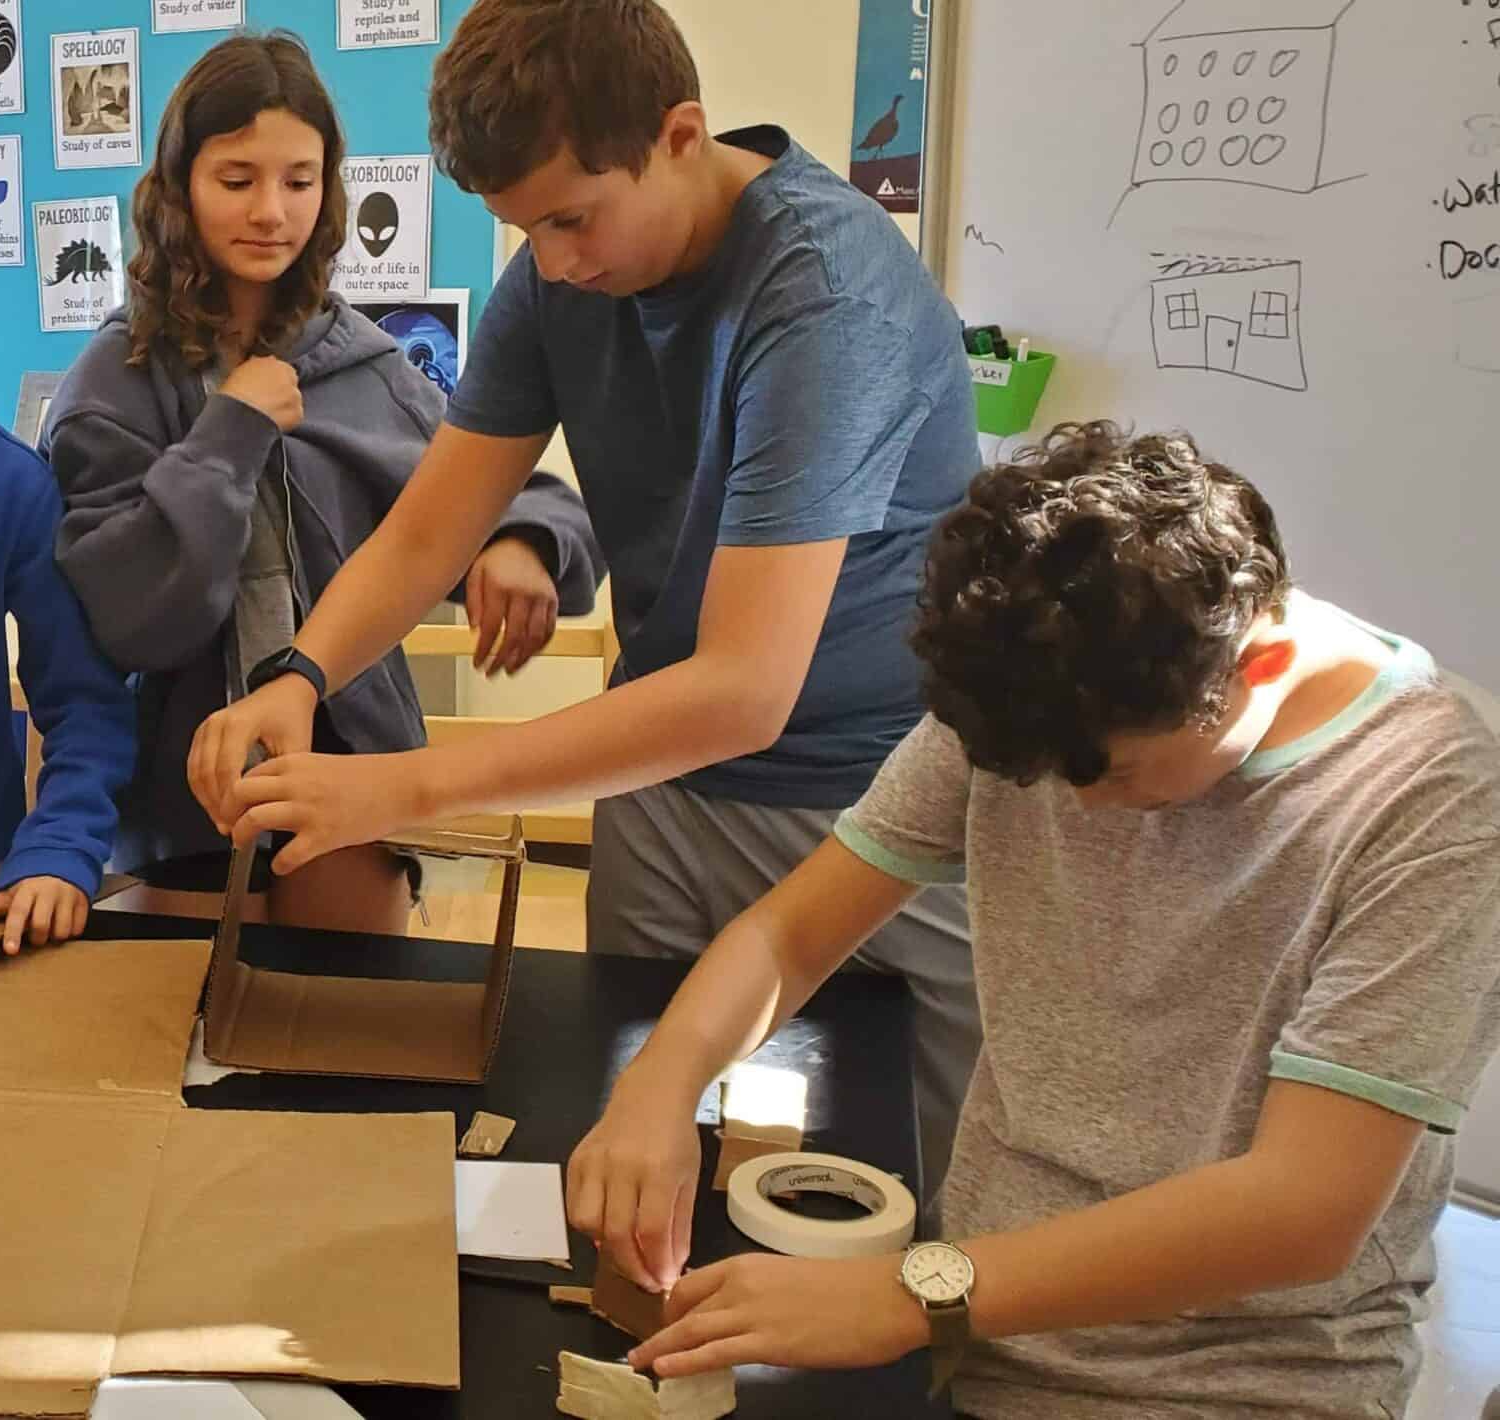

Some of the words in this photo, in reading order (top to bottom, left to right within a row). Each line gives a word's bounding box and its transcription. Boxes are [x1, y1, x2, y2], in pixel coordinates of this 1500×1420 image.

[159, 2, 188, 15] Study
[192, 0, 203, 13] of
[207, 0, 236, 11] water
[362, 0, 394, 9] Study
[355, 12, 396, 28] reptiles
[398, 10, 420, 22] and
[355, 28, 420, 44] amphibians
[62, 38, 127, 58] SPELEOLOGY
[61, 140, 90, 153] Study
[92, 138, 103, 150] of
[106, 139, 132, 150] caves
[343, 165, 420, 182] EXOBIOLOGY
[334, 262, 368, 276] Study
[371, 262, 385, 274] of
[387, 262, 406, 274] life
[408, 262, 420, 274] in
[345, 280, 376, 290] outer
[378, 280, 410, 292] space
[92, 296, 104, 307] of
